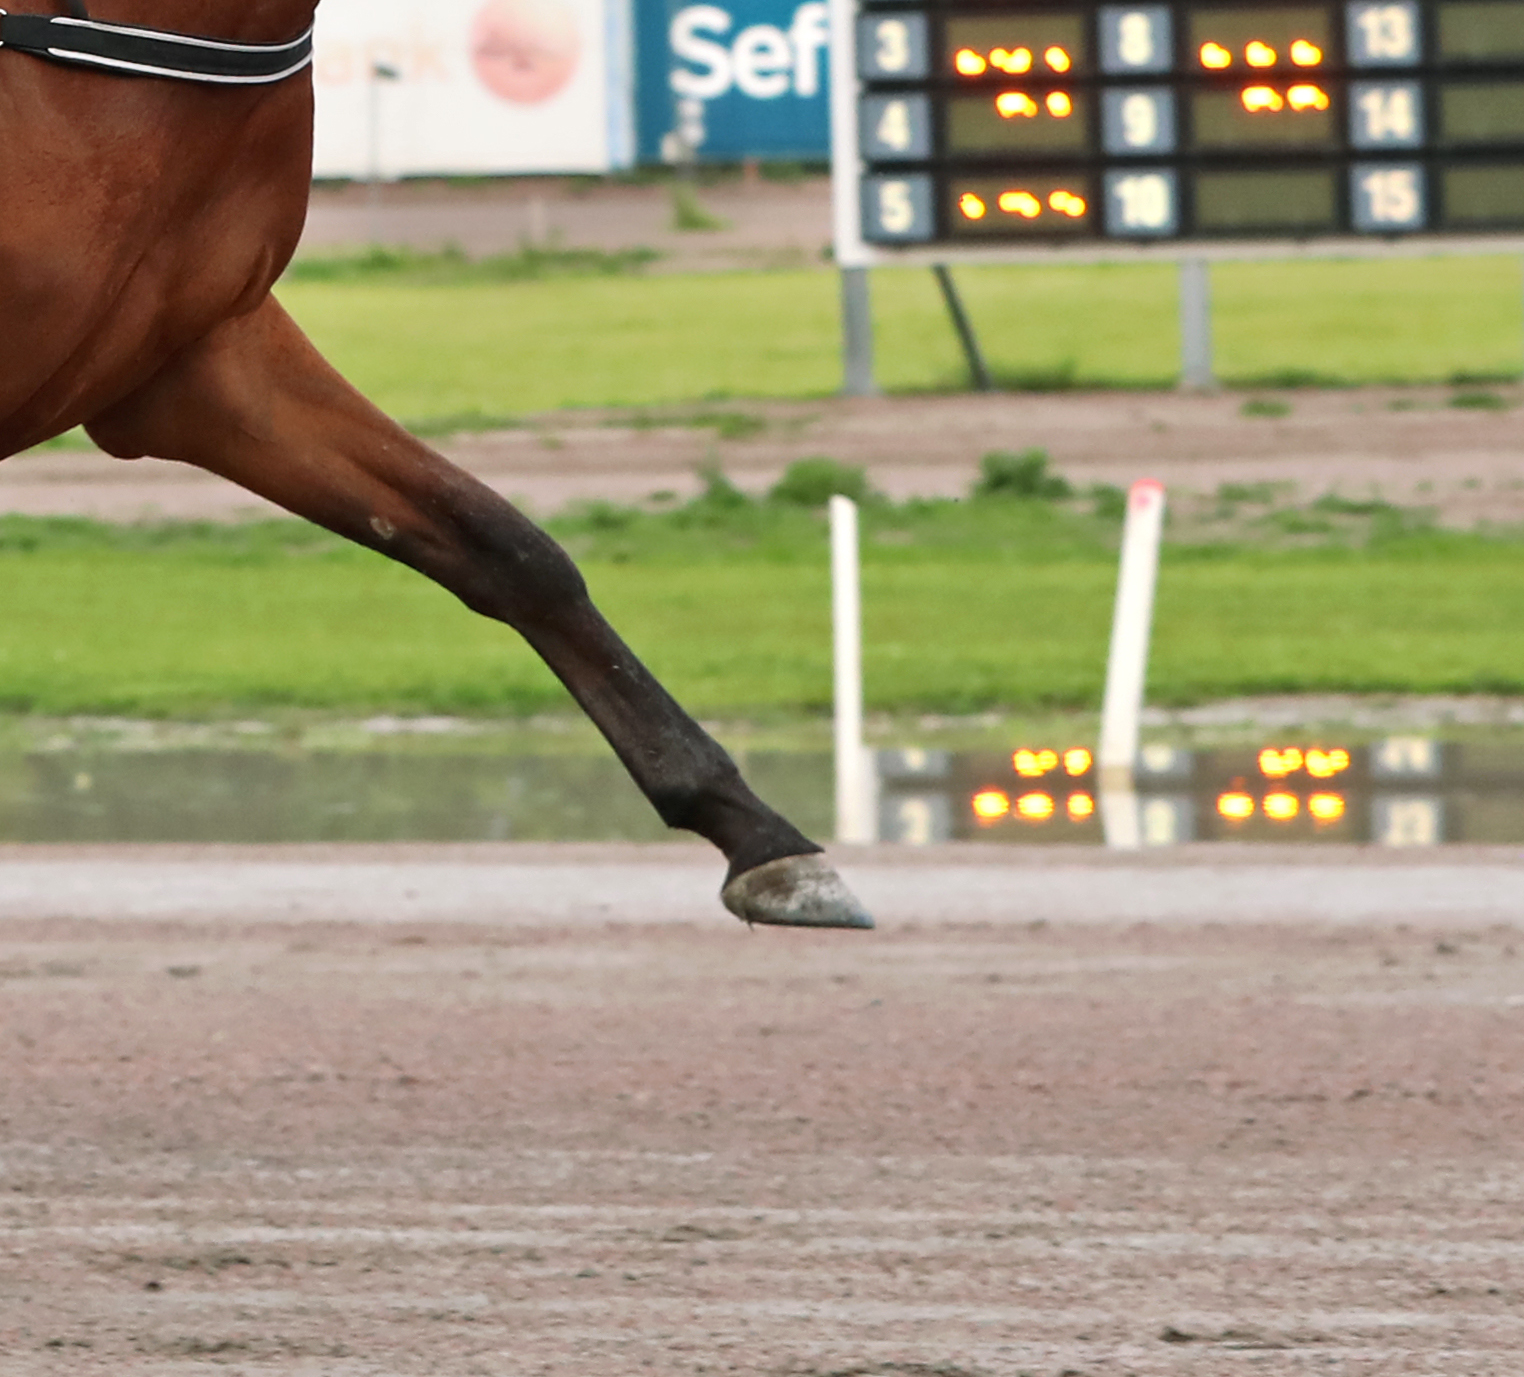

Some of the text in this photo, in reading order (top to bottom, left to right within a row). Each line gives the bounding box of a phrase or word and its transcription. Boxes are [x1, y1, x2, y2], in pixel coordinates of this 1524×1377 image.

[875, 20, 908, 72] 3
[1118, 12, 1151, 65] 8
[1359, 6, 1412, 59] 13
[876, 101, 911, 151] 4
[1120, 94, 1157, 148] 9
[1360, 87, 1414, 140] 14
[878, 181, 913, 230] 5
[1114, 173, 1171, 229] 10
[1362, 170, 1419, 223] 15
